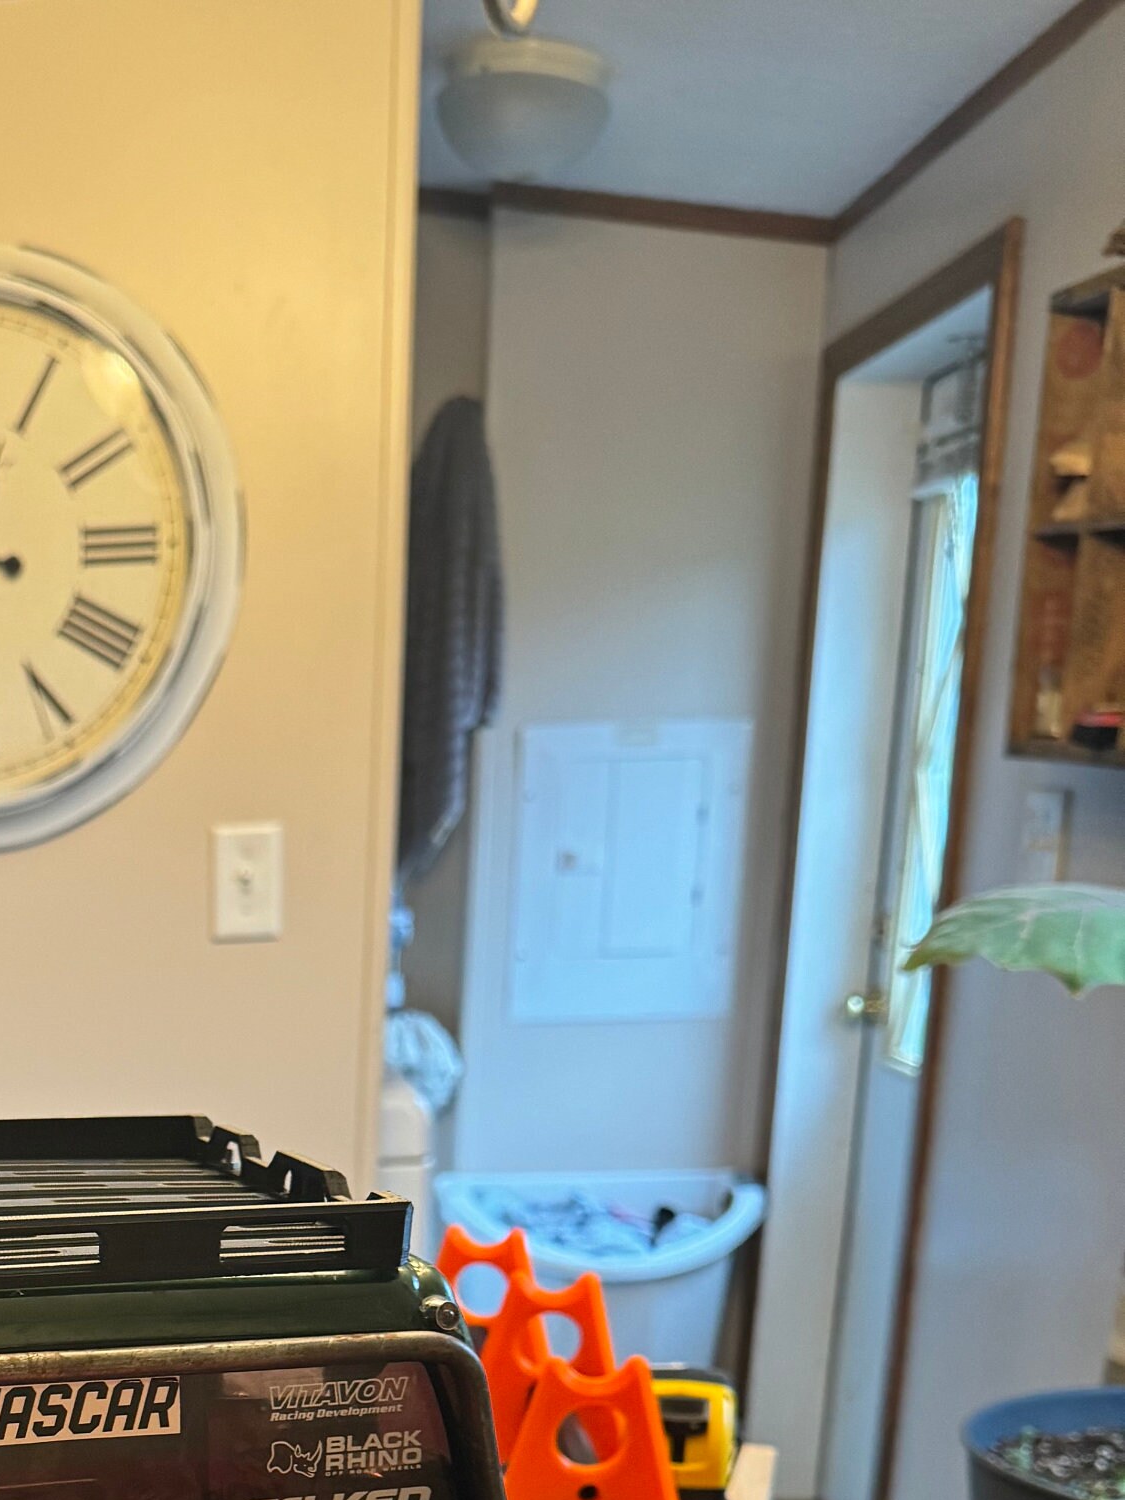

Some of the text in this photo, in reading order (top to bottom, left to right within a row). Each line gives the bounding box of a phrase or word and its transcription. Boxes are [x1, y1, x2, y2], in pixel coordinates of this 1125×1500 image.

[269, 1376, 408, 1410] VITAVON
[270, 1404, 403, 1422] Racing Development
[326, 1429, 422, 1454] BLACK
[326, 1447, 422, 1472] RHINO
